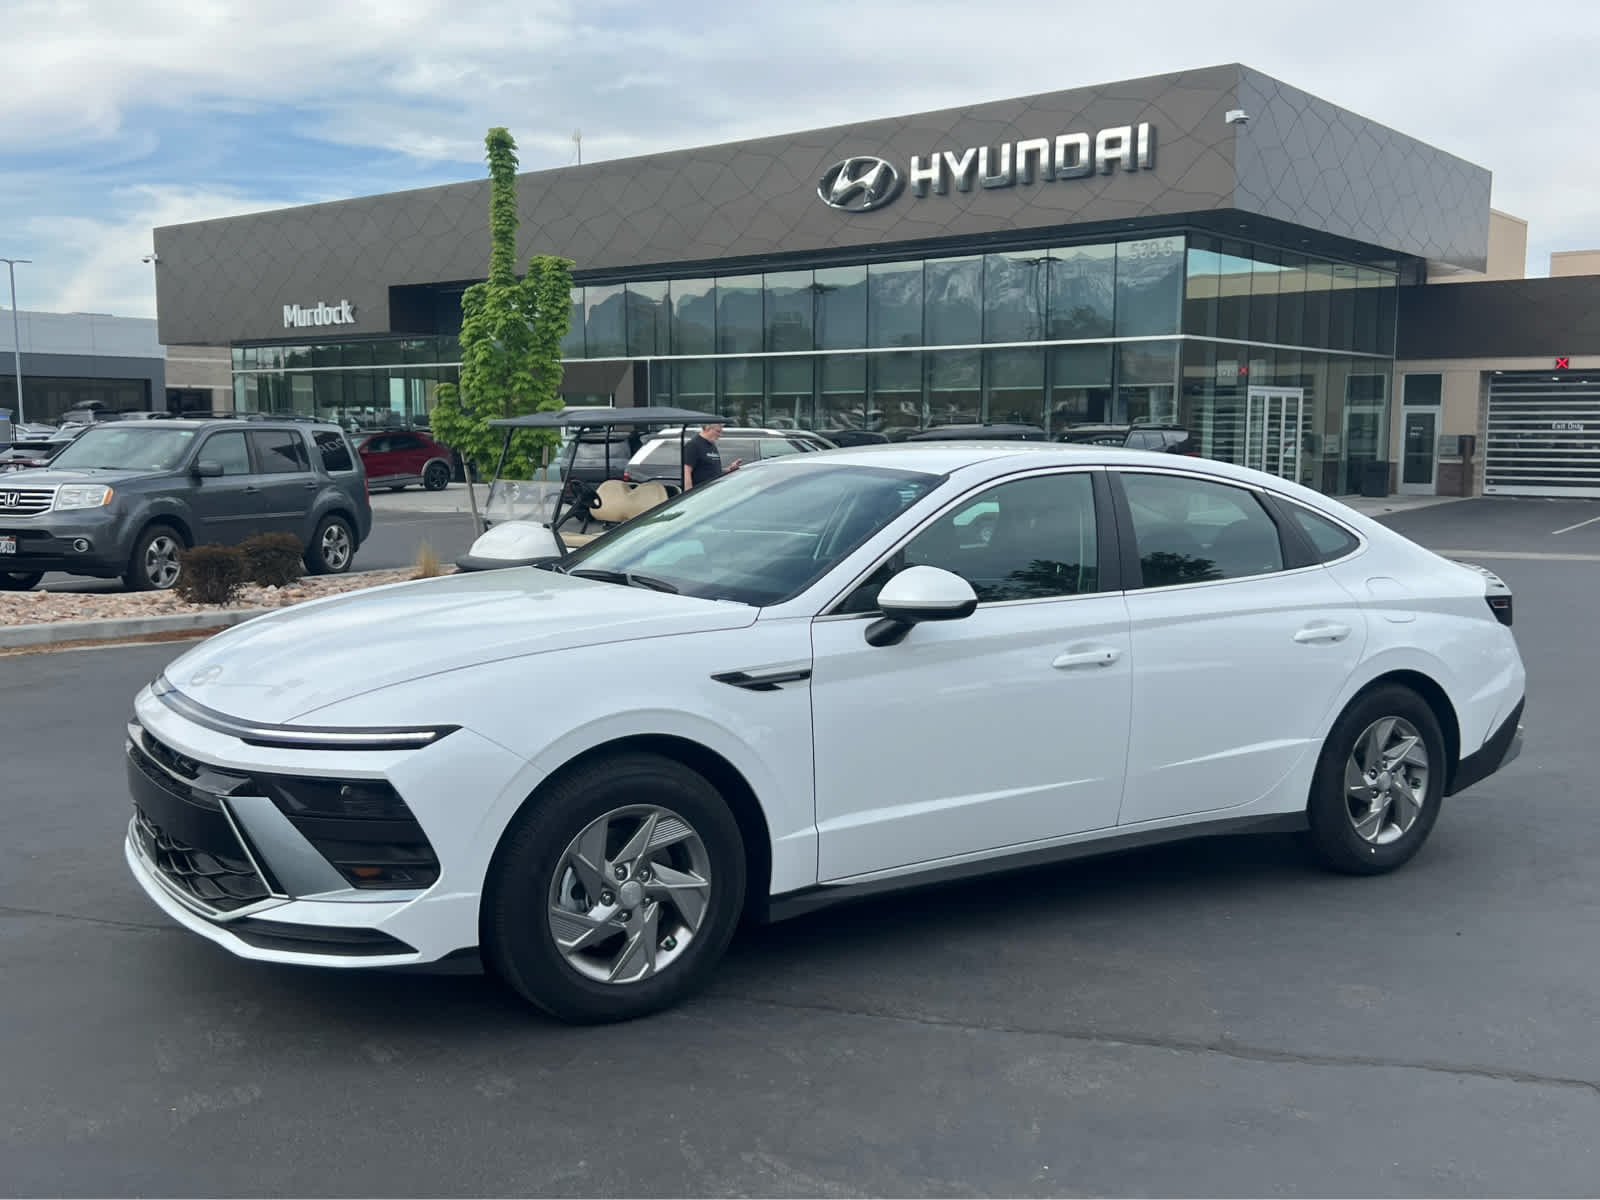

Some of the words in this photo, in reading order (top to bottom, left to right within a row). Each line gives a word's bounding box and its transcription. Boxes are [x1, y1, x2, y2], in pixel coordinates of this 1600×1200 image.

[910, 122, 1153, 198] HYUNDAI
[283, 299, 355, 328] Murdock
[1552, 421, 1566, 432] Exit
[1567, 421, 1585, 433] Only
